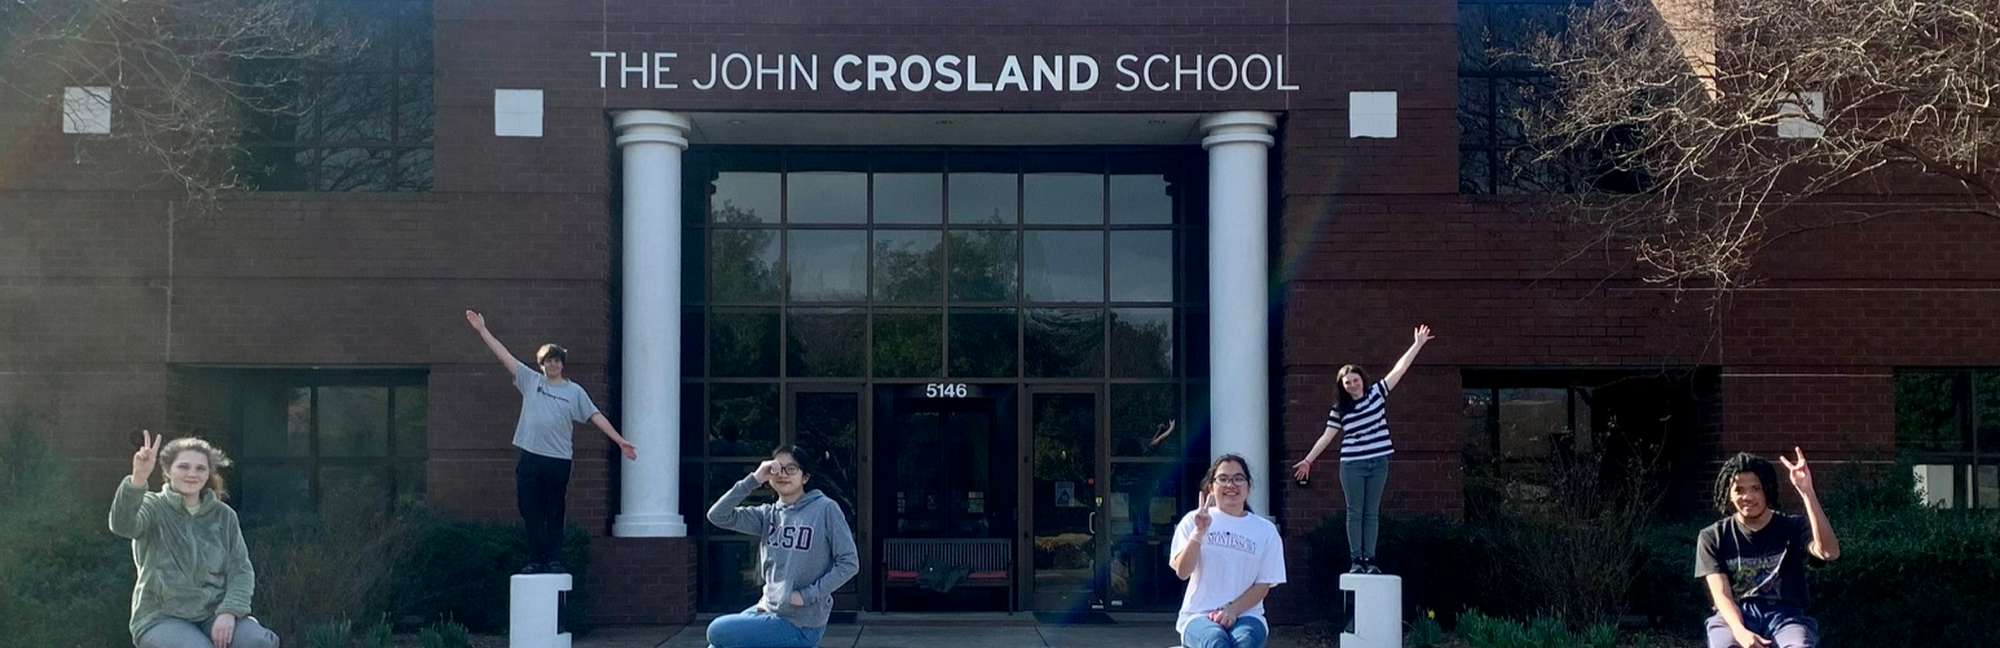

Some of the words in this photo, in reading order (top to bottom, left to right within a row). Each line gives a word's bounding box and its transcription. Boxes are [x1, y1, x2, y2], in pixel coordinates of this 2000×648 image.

[591, 52, 678, 89] THE
[693, 52, 818, 91] JOHN
[833, 53, 1099, 92] CROSLAND
[1115, 53, 1300, 92] SCHOOL
[926, 384, 967, 398] 5146
